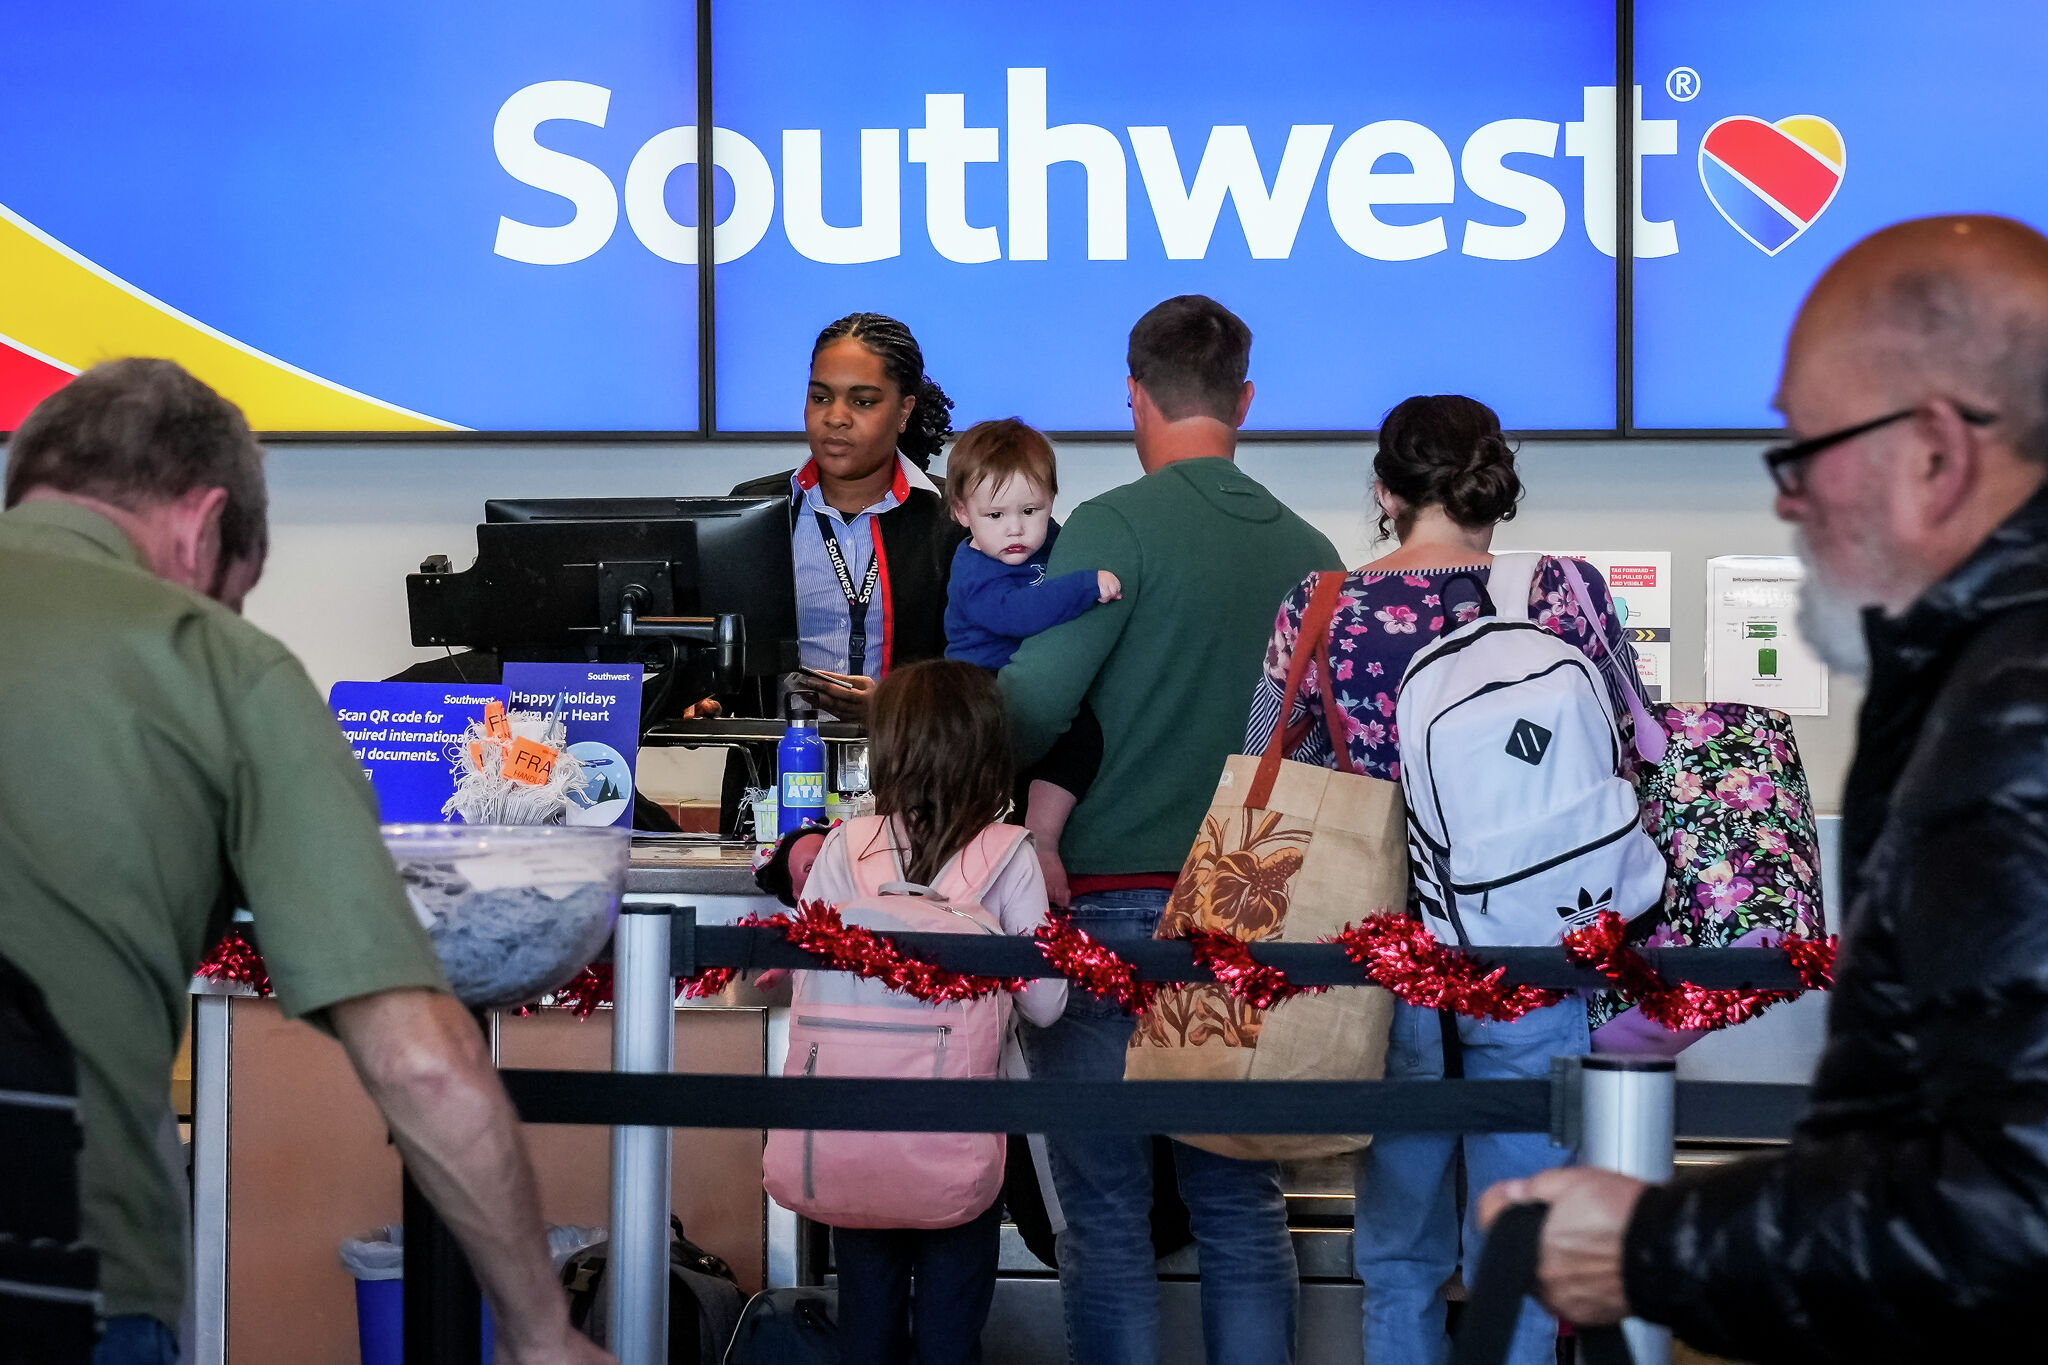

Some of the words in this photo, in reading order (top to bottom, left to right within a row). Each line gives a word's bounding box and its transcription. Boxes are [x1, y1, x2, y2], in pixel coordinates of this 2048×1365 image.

[494, 67, 1680, 265] Southwest
[826, 538, 855, 600] Southwest
[859, 553, 878, 603] Southw
[588, 672, 630, 680] Southwest
[444, 694, 495, 704] Southwest
[512, 692, 555, 706] Happy
[337, 708, 367, 722] Scan
[370, 710, 390, 724] QR
[392, 710, 422, 723] code
[424, 711, 444, 724] for
[572, 709, 609, 721] Heart
[342, 728, 387, 744] quired
[389, 728, 464, 743] internationa
[368, 748, 440, 762] documents.
[788, 776, 822, 786] LOVE
[788, 786, 822, 798] ATX
